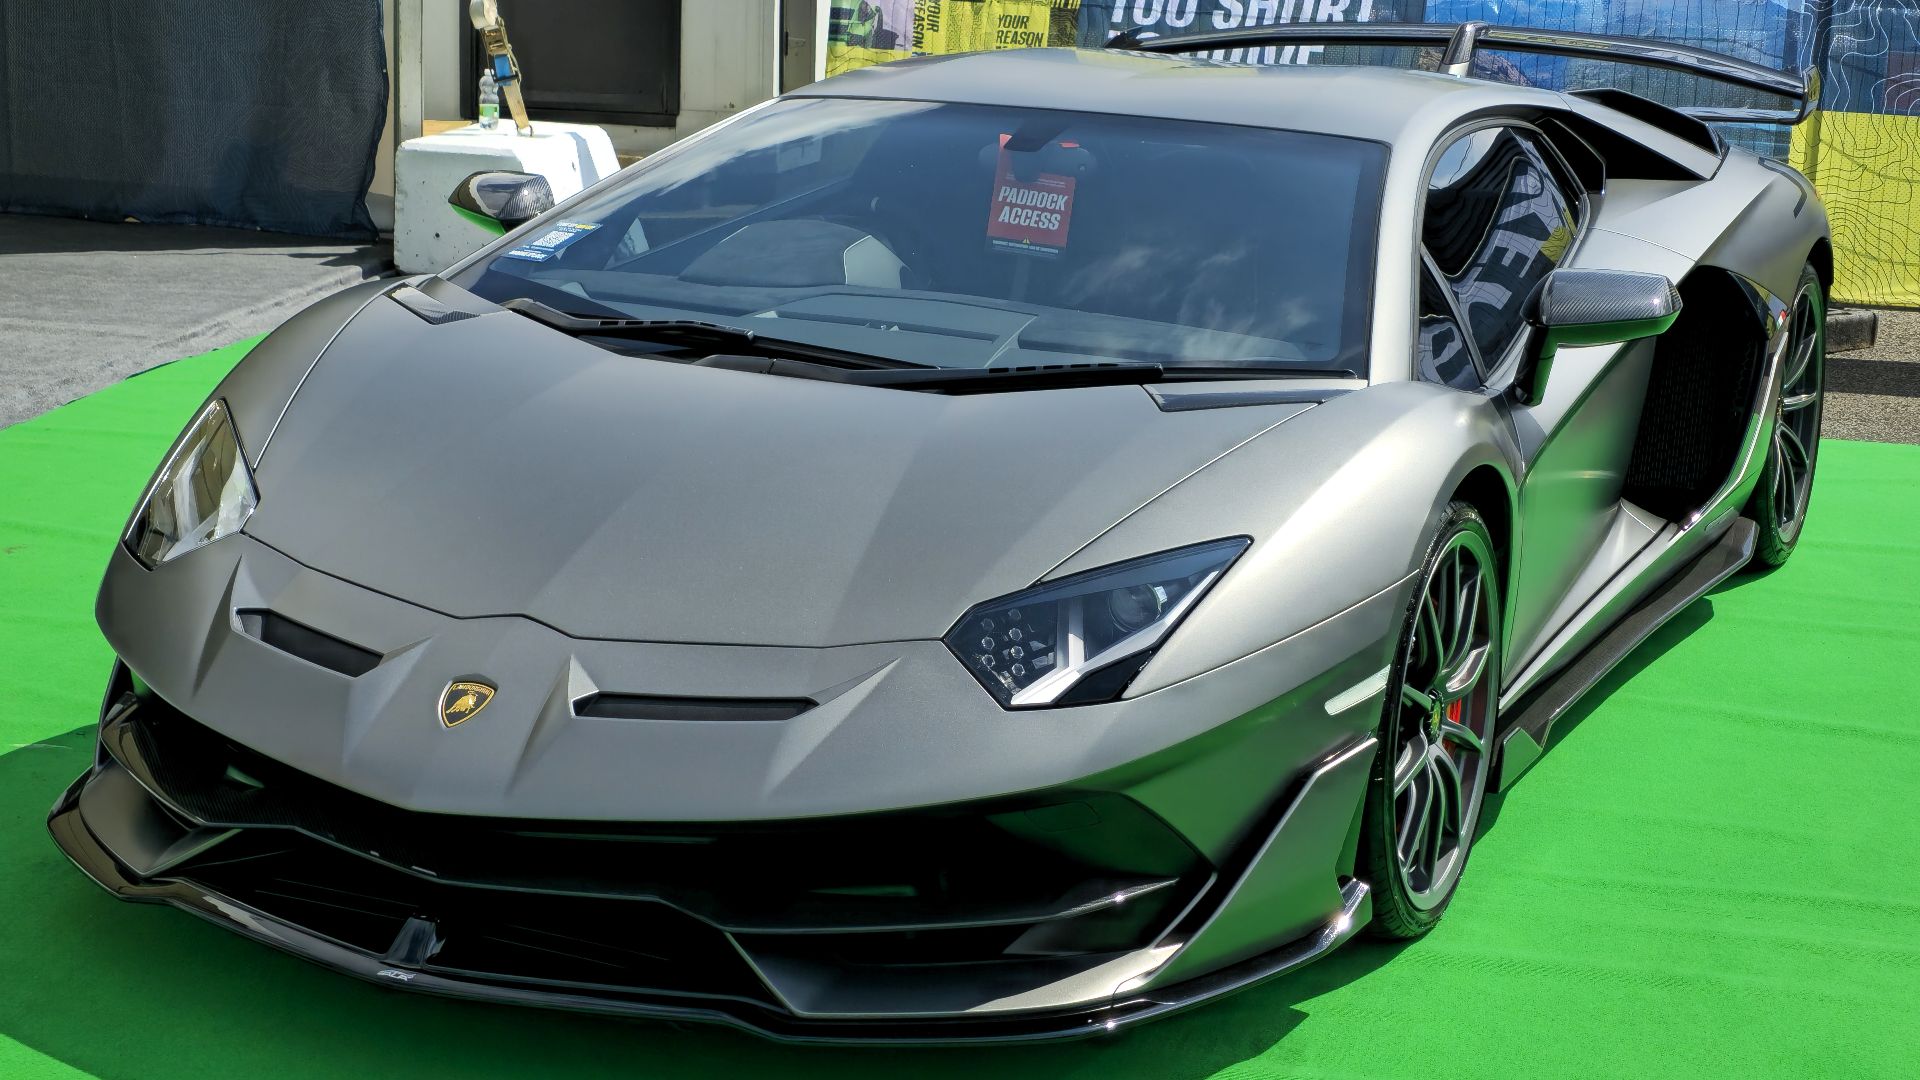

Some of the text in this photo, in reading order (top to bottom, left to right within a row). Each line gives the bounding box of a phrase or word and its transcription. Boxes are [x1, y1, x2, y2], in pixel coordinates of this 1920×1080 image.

[998, 14, 1030, 29] YOUR
[995, 30, 1044, 47] REASON
[998, 185, 1068, 211] PADDOCK
[998, 205, 1061, 230] ACCESS
